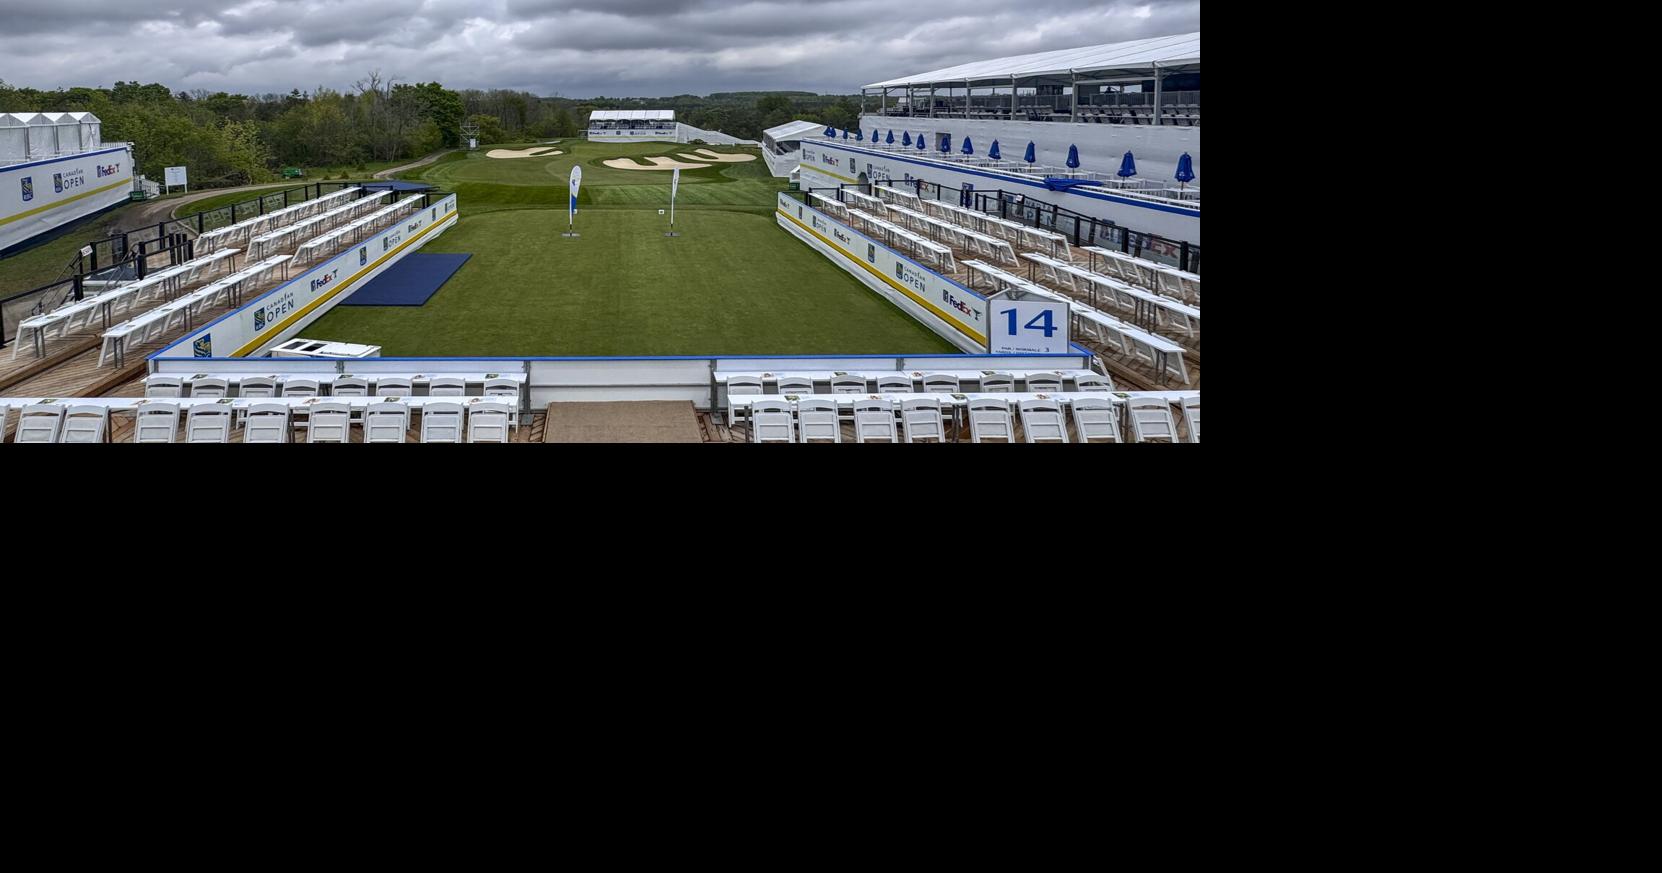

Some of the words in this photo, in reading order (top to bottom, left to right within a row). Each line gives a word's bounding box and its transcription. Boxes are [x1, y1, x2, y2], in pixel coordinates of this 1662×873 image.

[64, 176, 85, 190] OPEN
[316, 273, 333, 290] FedEx
[903, 273, 926, 292] OPEN
[266, 299, 295, 323] OPEN
[267, 292, 294, 311] CANADIAN
[949, 295, 972, 317] FedEx
[1000, 308, 1058, 338] 14
